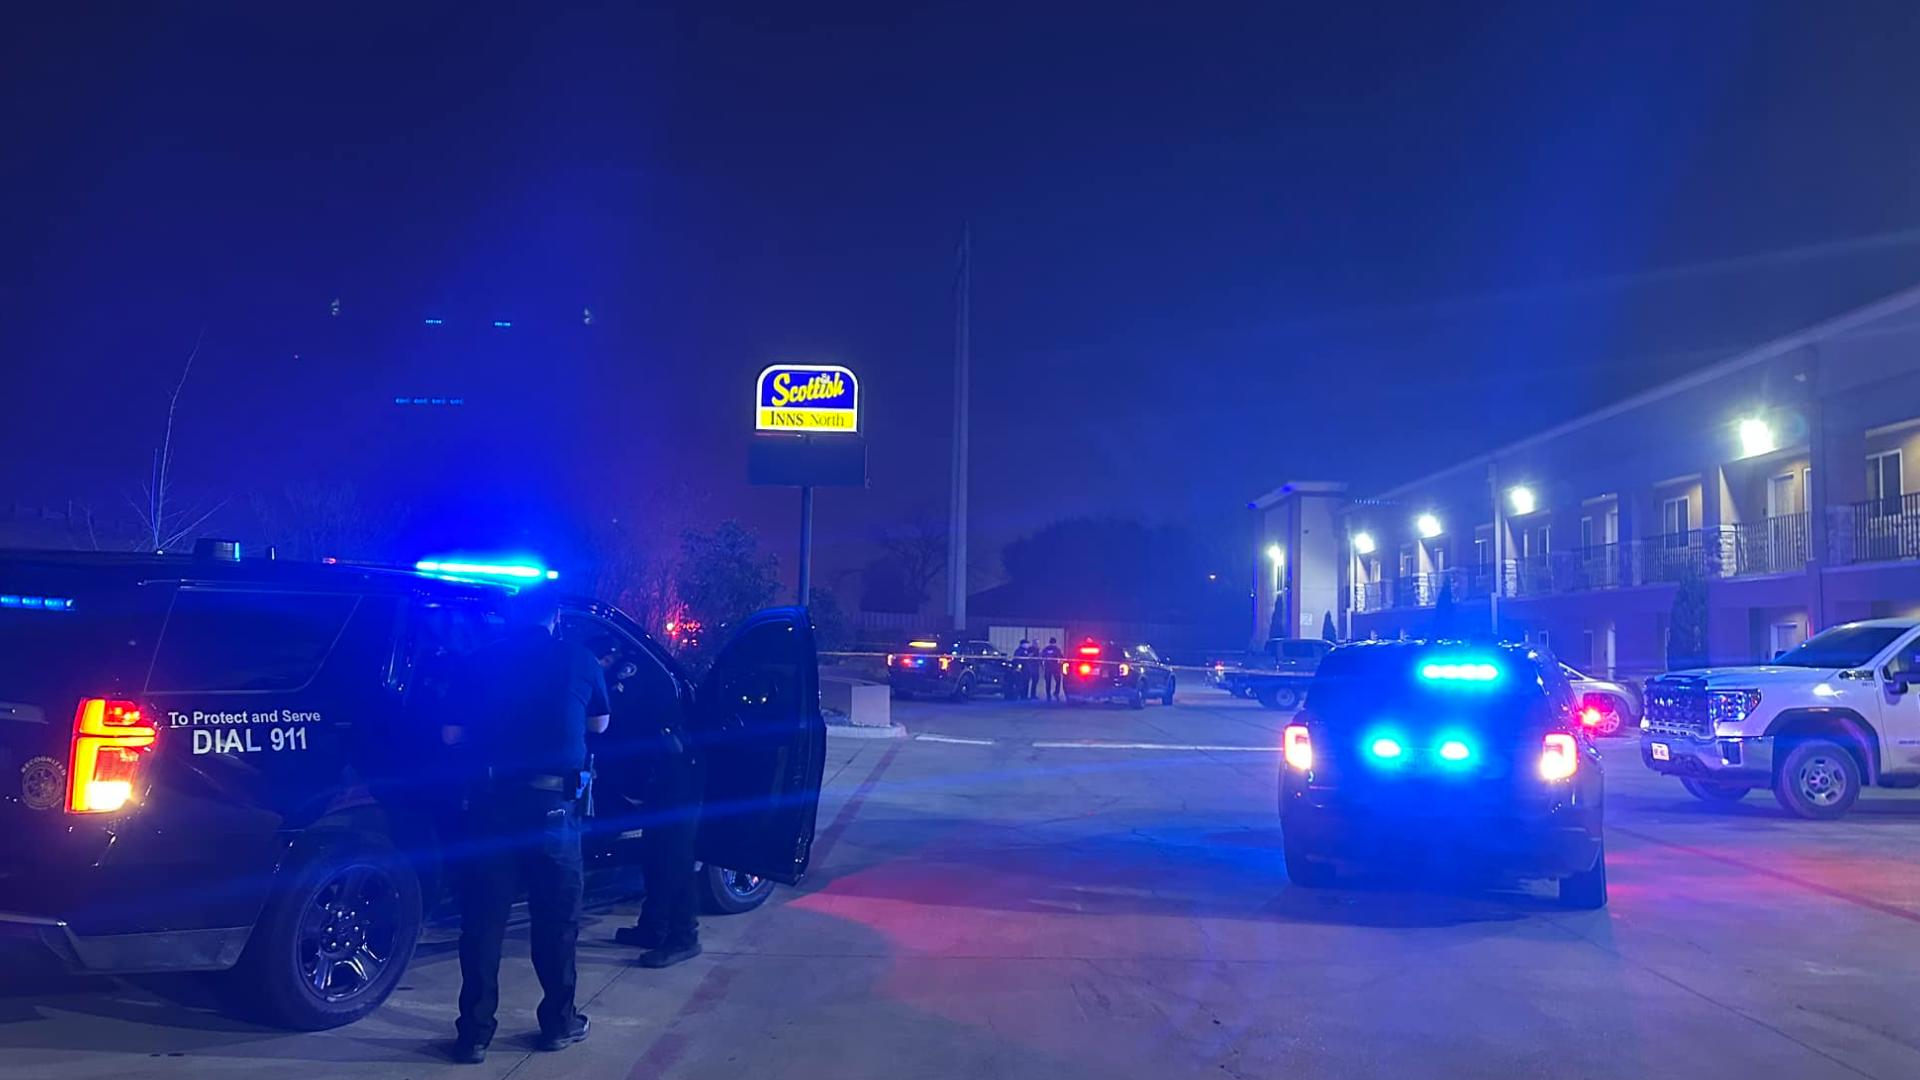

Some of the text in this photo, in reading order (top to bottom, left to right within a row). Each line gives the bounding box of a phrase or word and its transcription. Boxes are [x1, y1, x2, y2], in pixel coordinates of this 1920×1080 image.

[771, 372, 845, 407] Scottish
[770, 410, 845, 427] INNS North
[168, 709, 321, 726] To Protect and Serve
[192, 726, 307, 755] DIAL 911
